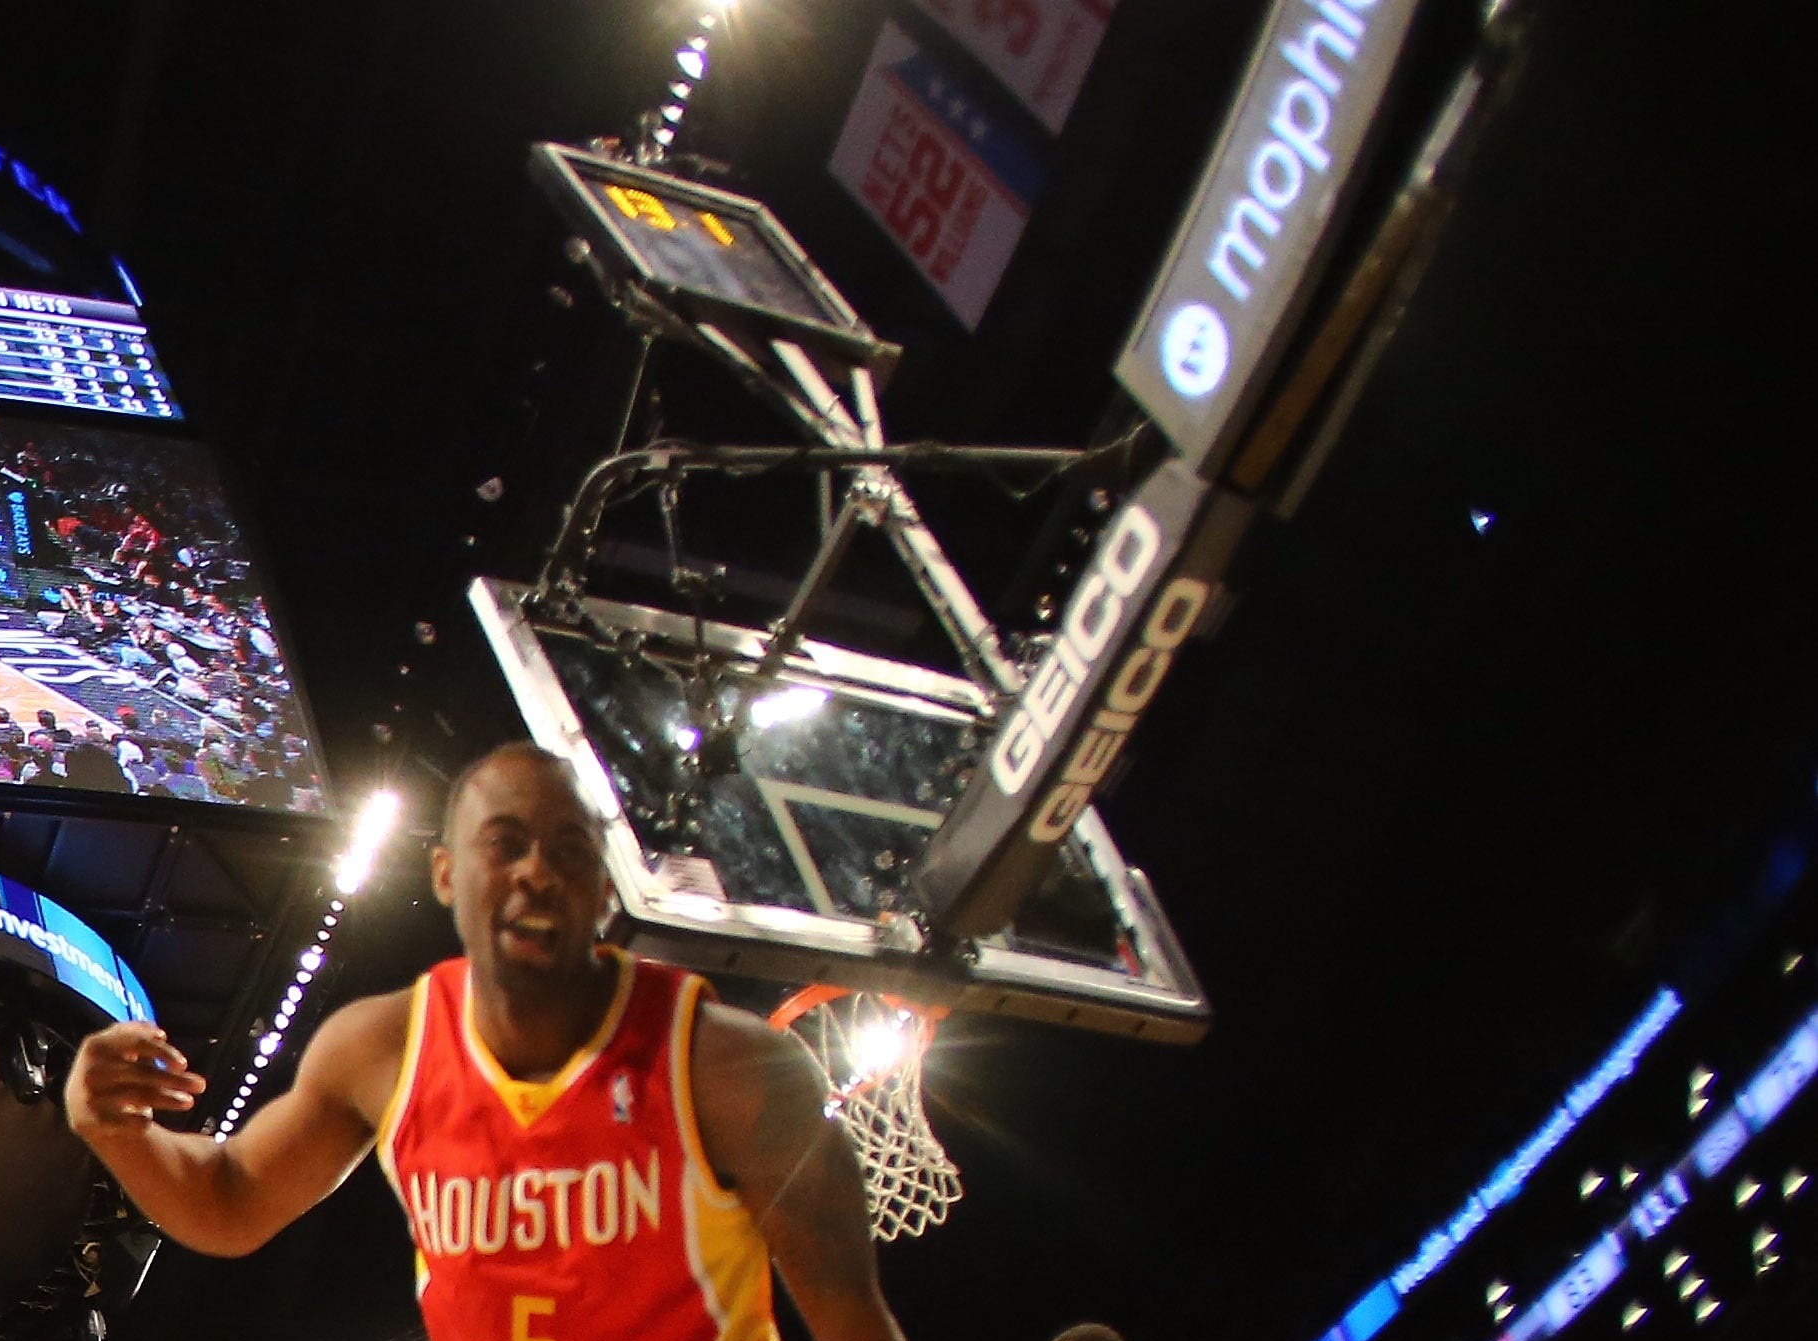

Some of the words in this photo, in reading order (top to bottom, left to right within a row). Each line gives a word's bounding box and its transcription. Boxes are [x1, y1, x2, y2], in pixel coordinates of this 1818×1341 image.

[887, 133, 966, 258] 52
[1206, 0, 1379, 301] mophi
[14, 291, 73, 315] NETS
[81, 366, 99, 378] 0
[112, 370, 129, 382] 0
[119, 384, 134, 397] 4
[157, 403, 172, 417] 2
[991, 504, 1161, 796] GEICO
[1030, 578, 1208, 843] GEICO
[410, 1147, 661, 1258] HOUSTON
